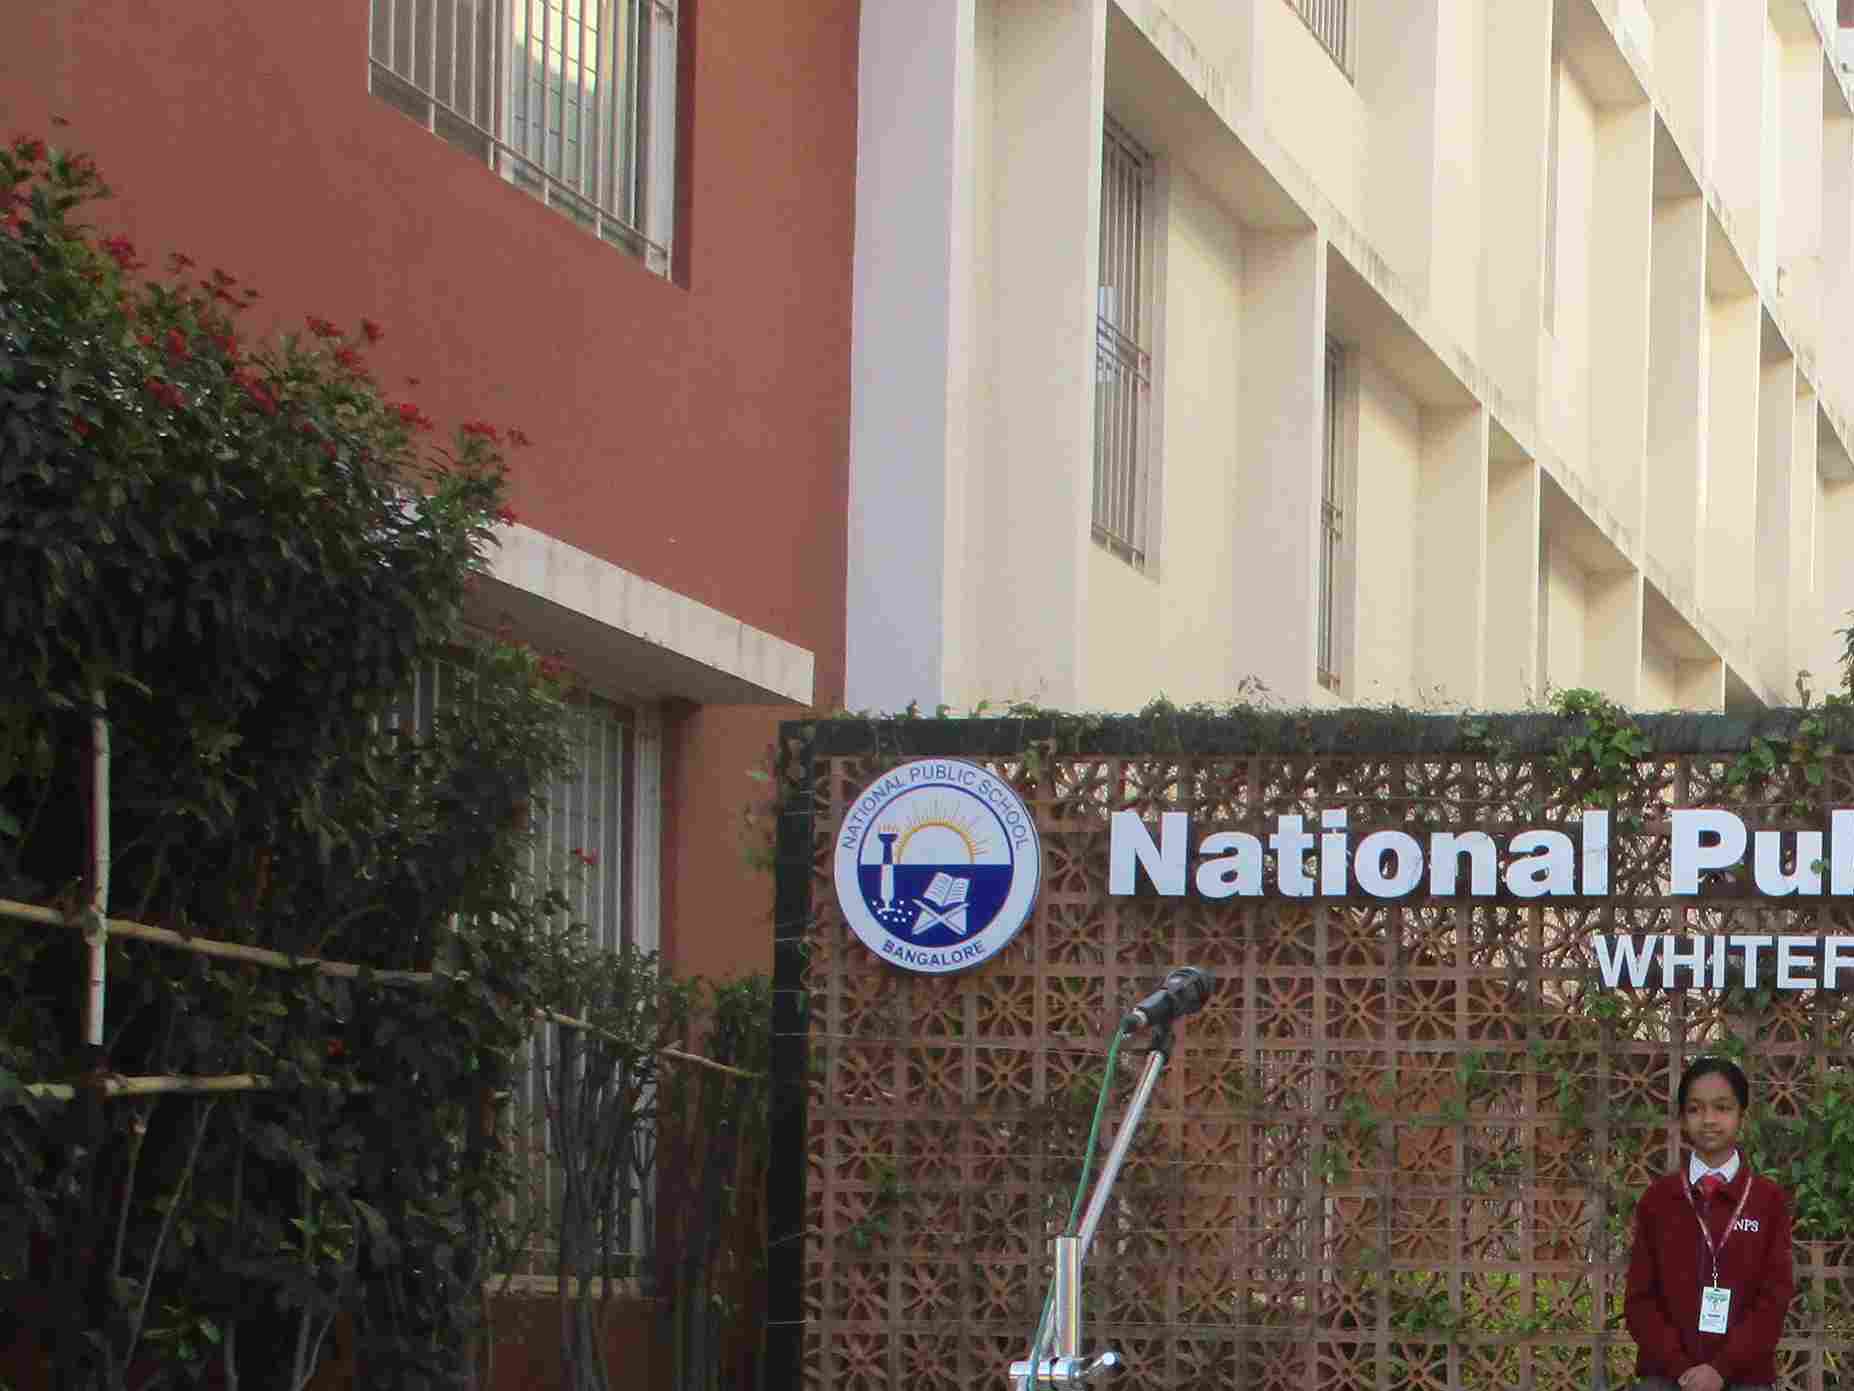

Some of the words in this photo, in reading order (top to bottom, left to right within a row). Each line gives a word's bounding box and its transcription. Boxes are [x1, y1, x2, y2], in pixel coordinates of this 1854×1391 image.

[842, 774, 904, 850] NATIONAL
[909, 764, 976, 786] PUBLIC
[978, 778, 1031, 851] SCHOOL
[1108, 808, 1609, 898] National
[881, 938, 986, 967] BANGALORE
[1732, 1218, 1760, 1233] NPS
